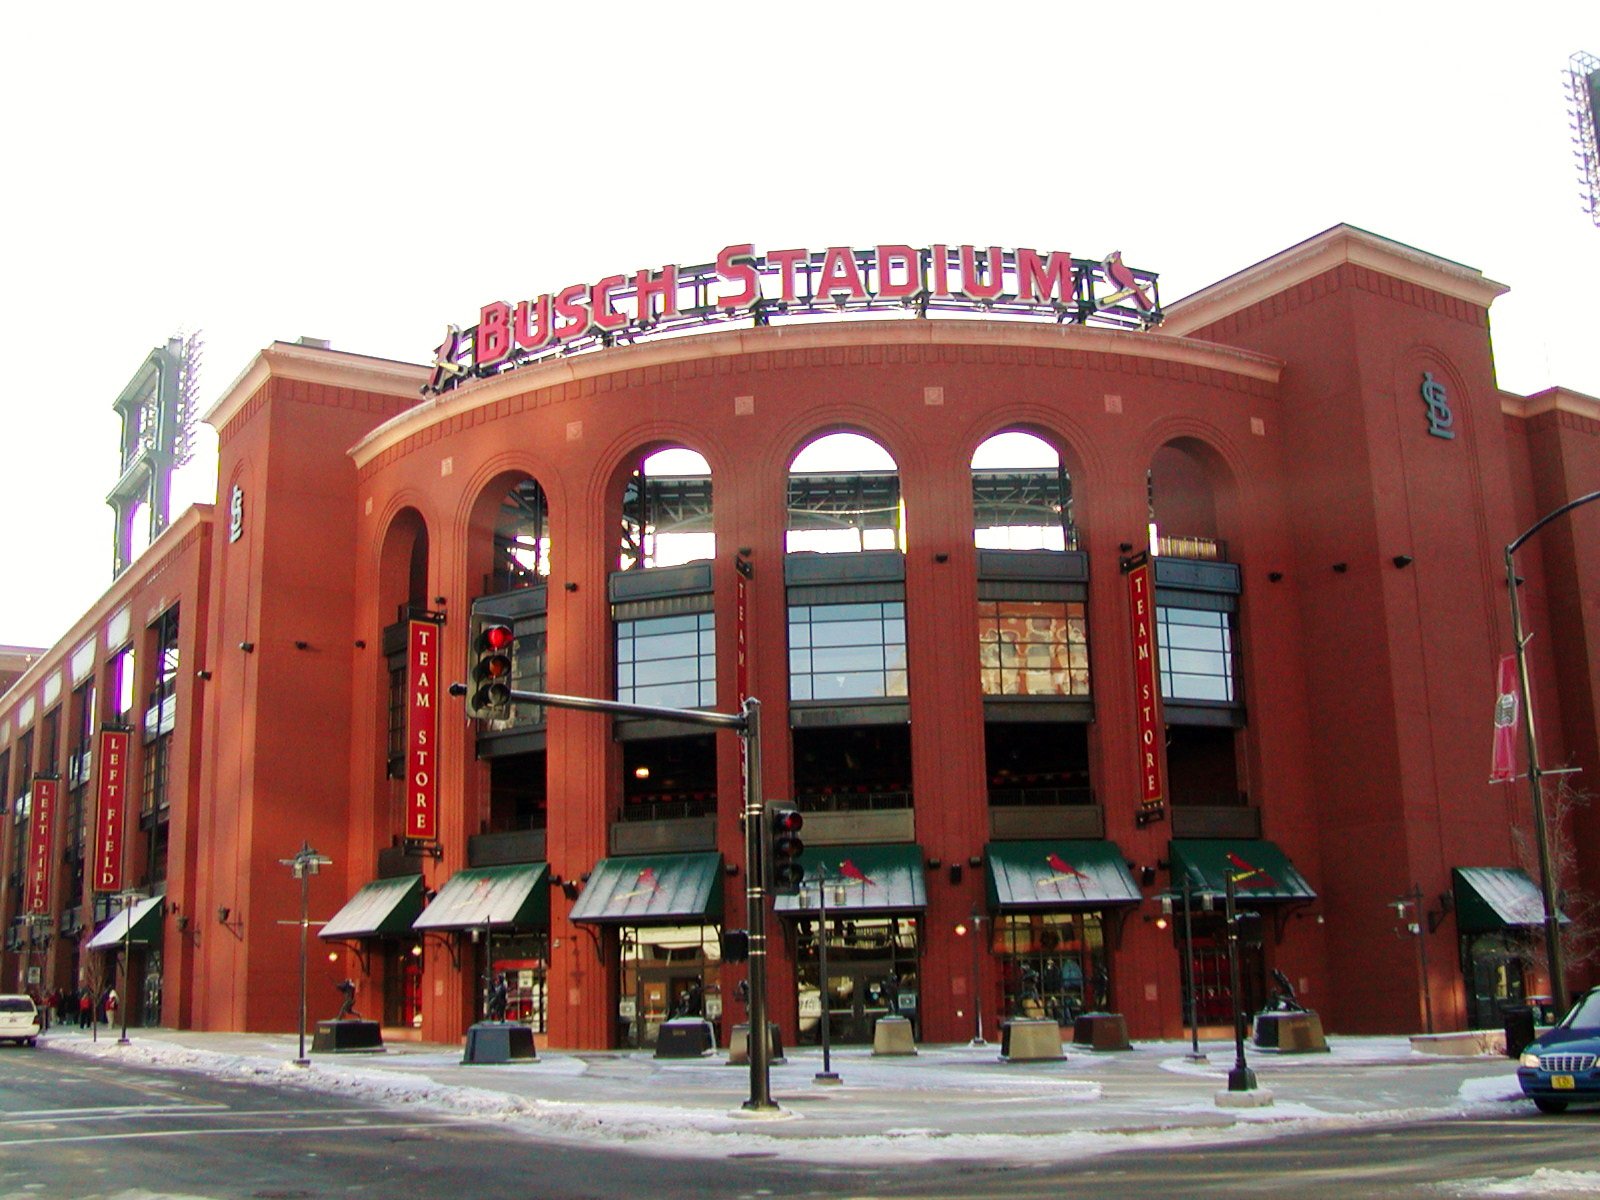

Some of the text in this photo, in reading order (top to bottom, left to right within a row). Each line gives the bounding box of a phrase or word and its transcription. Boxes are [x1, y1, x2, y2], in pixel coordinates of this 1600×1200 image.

[476, 243, 1079, 368] BUSCH STADIUM
[415, 630, 430, 829] TEAM STORE
[1134, 577, 1155, 791] TEAM STORE
[33, 785, 49, 909] LEFT FIELD
[102, 737, 119, 885] LEFT FIELD
